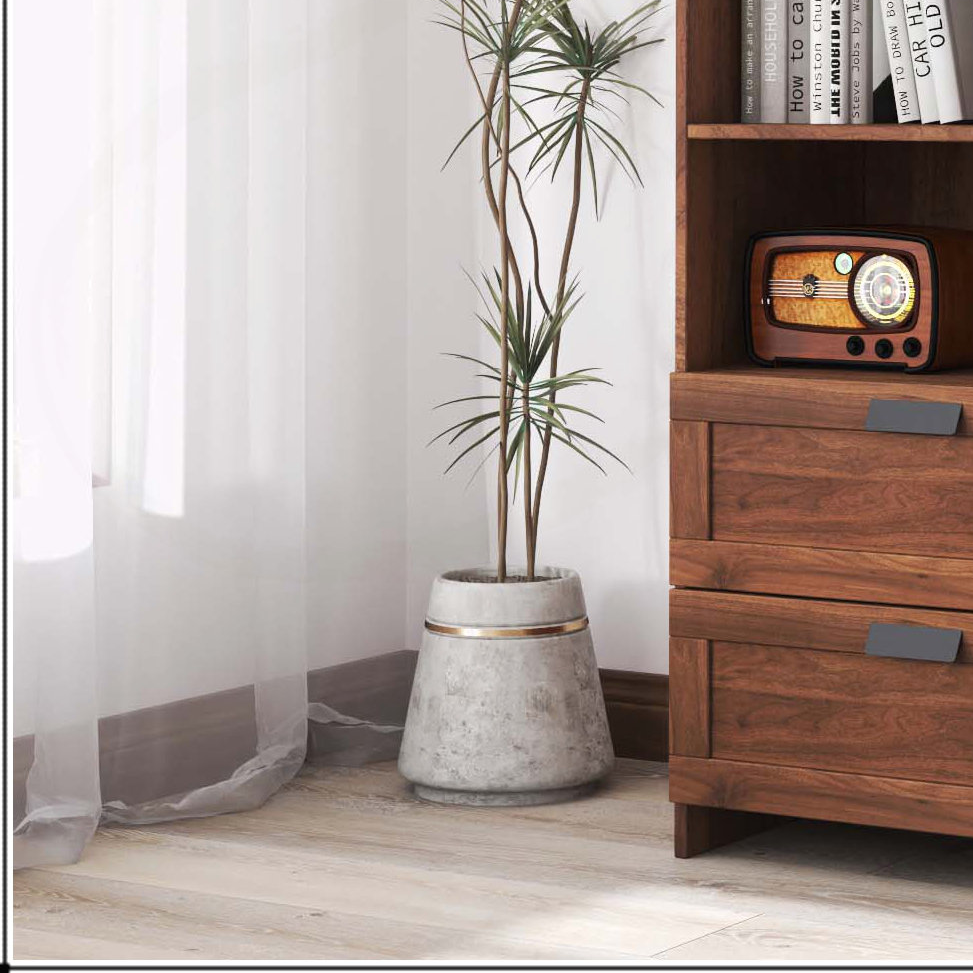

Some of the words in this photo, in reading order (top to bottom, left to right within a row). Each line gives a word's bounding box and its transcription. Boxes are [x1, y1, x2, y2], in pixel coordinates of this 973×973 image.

[747, 33, 753, 45] an
[852, 19, 862, 34] by
[926, 3, 945, 48] OLD
[790, 39, 804, 61] to
[852, 42, 860, 72] Jobs
[892, 26, 902, 59] DRAW
[912, 39, 931, 77] CAR
[746, 79, 753, 90] to
[813, 43, 822, 112] Winston
[896, 66, 903, 84] TO
[790, 76, 804, 112] How
[852, 80, 860, 118] Steve
[899, 90, 909, 116] HOW
